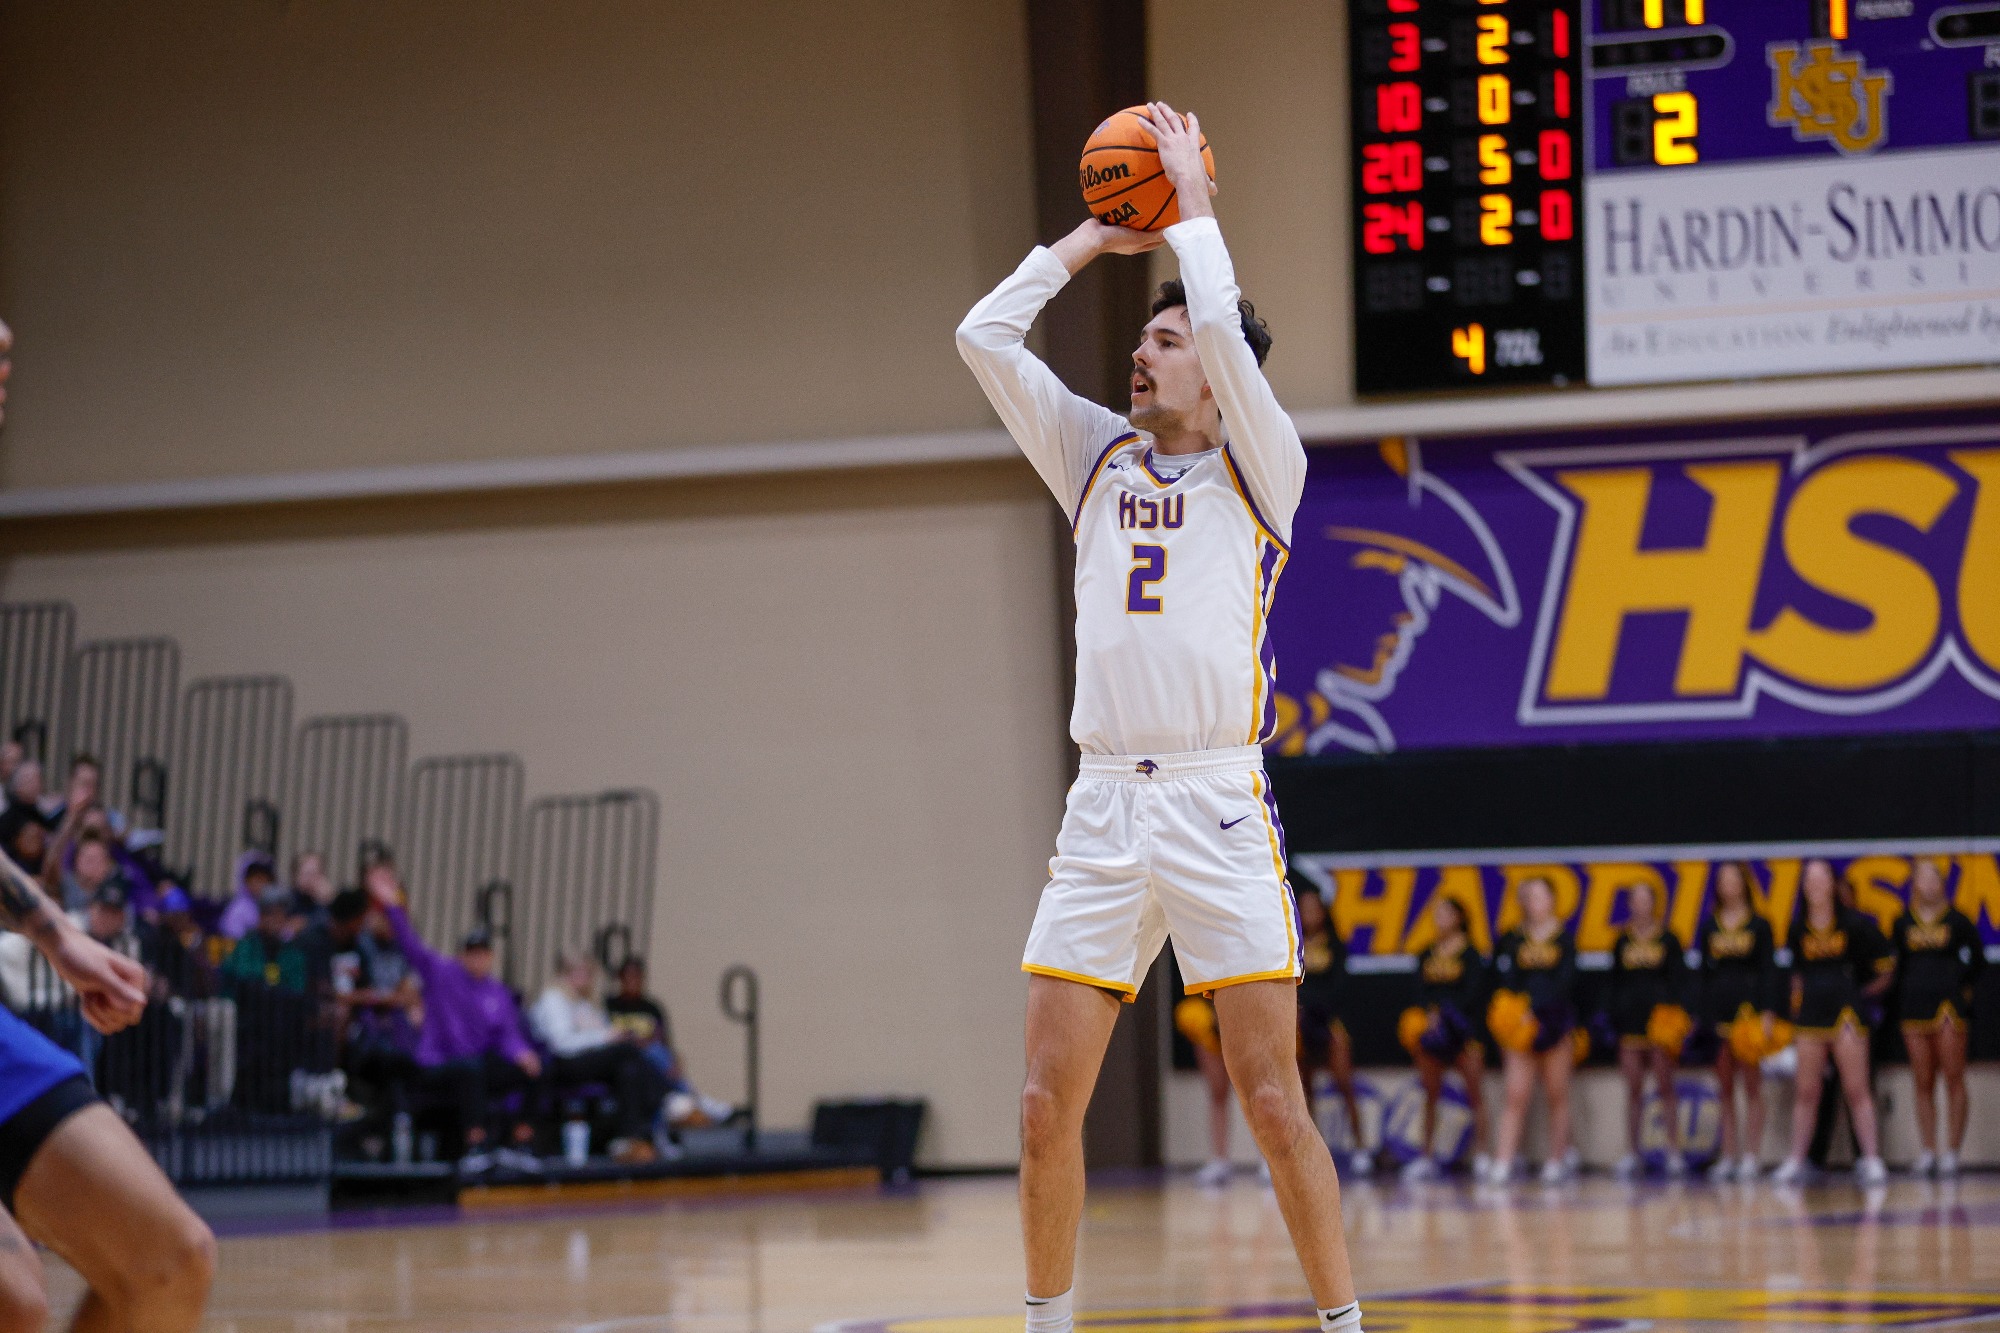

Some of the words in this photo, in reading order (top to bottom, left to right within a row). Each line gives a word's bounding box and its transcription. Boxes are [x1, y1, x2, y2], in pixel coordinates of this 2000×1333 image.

[1388, 22, 1420, 72] 3
[1477, 14, 1509, 64] 2
[1553, 8, 1569, 58] 1
[1377, 81, 1422, 133] 10
[1478, 74, 1510, 125] 0
[1554, 69, 1570, 118] 1
[1654, 92, 1698, 165] 2
[1080, 164, 1131, 192] ilson
[1362, 140, 1423, 194] 20
[1478, 134, 1512, 185] 5
[1539, 129, 1571, 180] 0
[1100, 201, 1140, 225] CAA
[1363, 200, 1424, 254] 24
[1479, 194, 1513, 245] 2
[1540, 189, 1573, 240] 0
[1452, 323, 1485, 374] 4
[1119, 489, 1184, 530] HSU
[1126, 542, 1168, 615] 2
